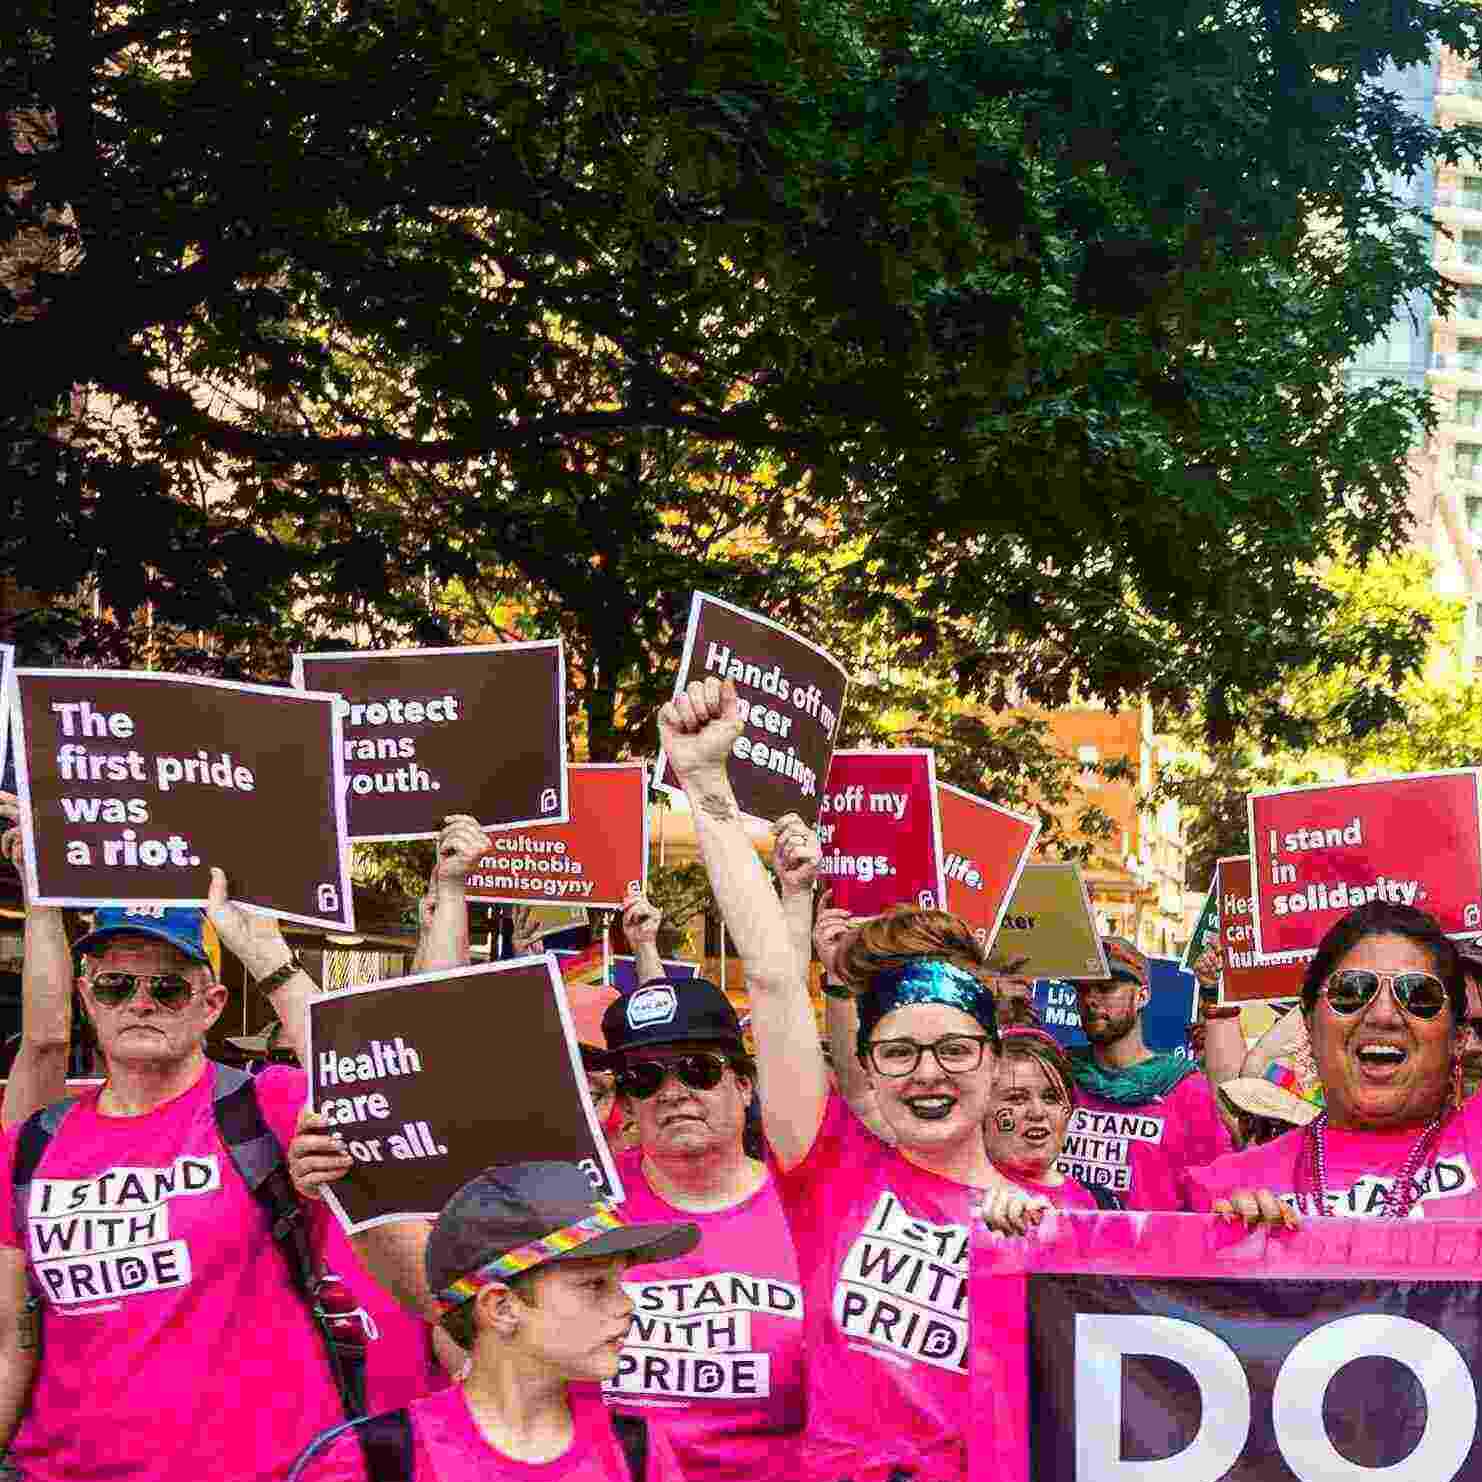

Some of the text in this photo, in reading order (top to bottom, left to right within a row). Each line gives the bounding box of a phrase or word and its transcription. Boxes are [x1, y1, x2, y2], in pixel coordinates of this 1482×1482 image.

[704, 641, 790, 702] Hands
[791, 683, 823, 718] off
[52, 701, 134, 737] The
[56, 744, 256, 791] first pride
[343, 736, 415, 761] rans
[60, 797, 149, 823] was
[834, 785, 865, 813] off
[870, 791, 909, 819] my
[64, 829, 201, 866] a riot.
[495, 835, 566, 855] culture
[1269, 815, 1363, 855] I stand
[1271, 858, 1297, 884] in
[1272, 874, 1427, 916] solidarity.
[319, 1038, 422, 1087] Health
[320, 1092, 391, 1125] care
[1075, 1110, 1160, 1138] STAND
[386, 1120, 449, 1160] all.
[40, 1159, 213, 1213] I STAND
[35, 1213, 156, 1255] WITH
[42, 1249, 181, 1300] PRIDE
[640, 1276, 797, 1312] STAND
[609, 1353, 758, 1395] PRIDE
